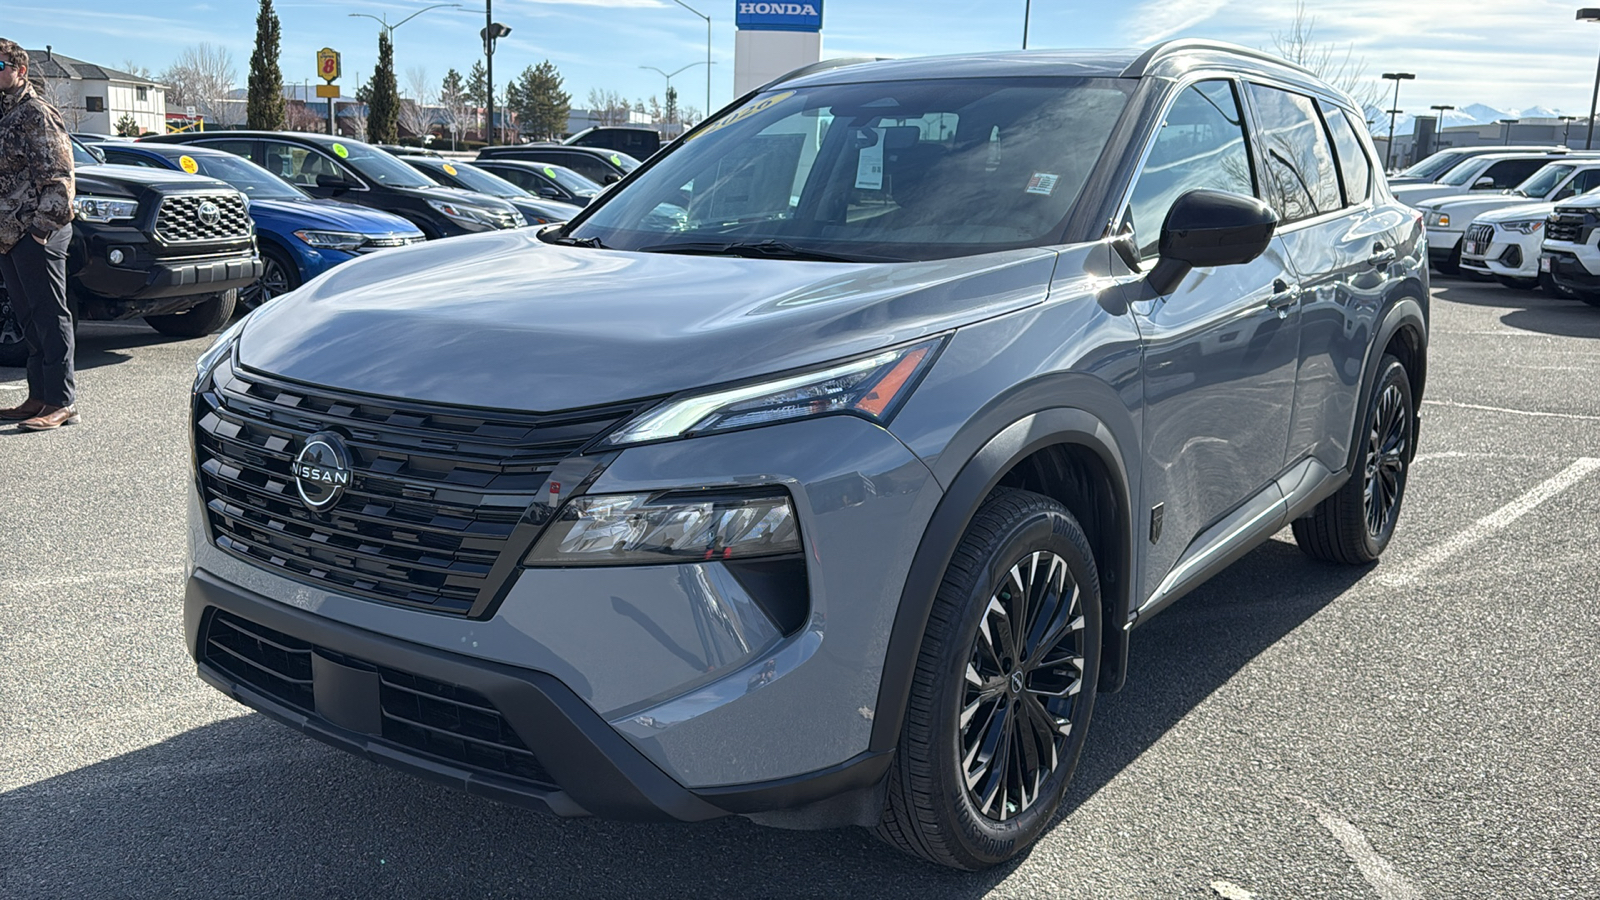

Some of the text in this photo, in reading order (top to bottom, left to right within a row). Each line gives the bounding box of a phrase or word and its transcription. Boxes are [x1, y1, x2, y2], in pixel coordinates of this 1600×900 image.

[740, 3, 818, 16] HONDA
[323, 58, 335, 74] 8
[292, 462, 347, 484] NISSAN
